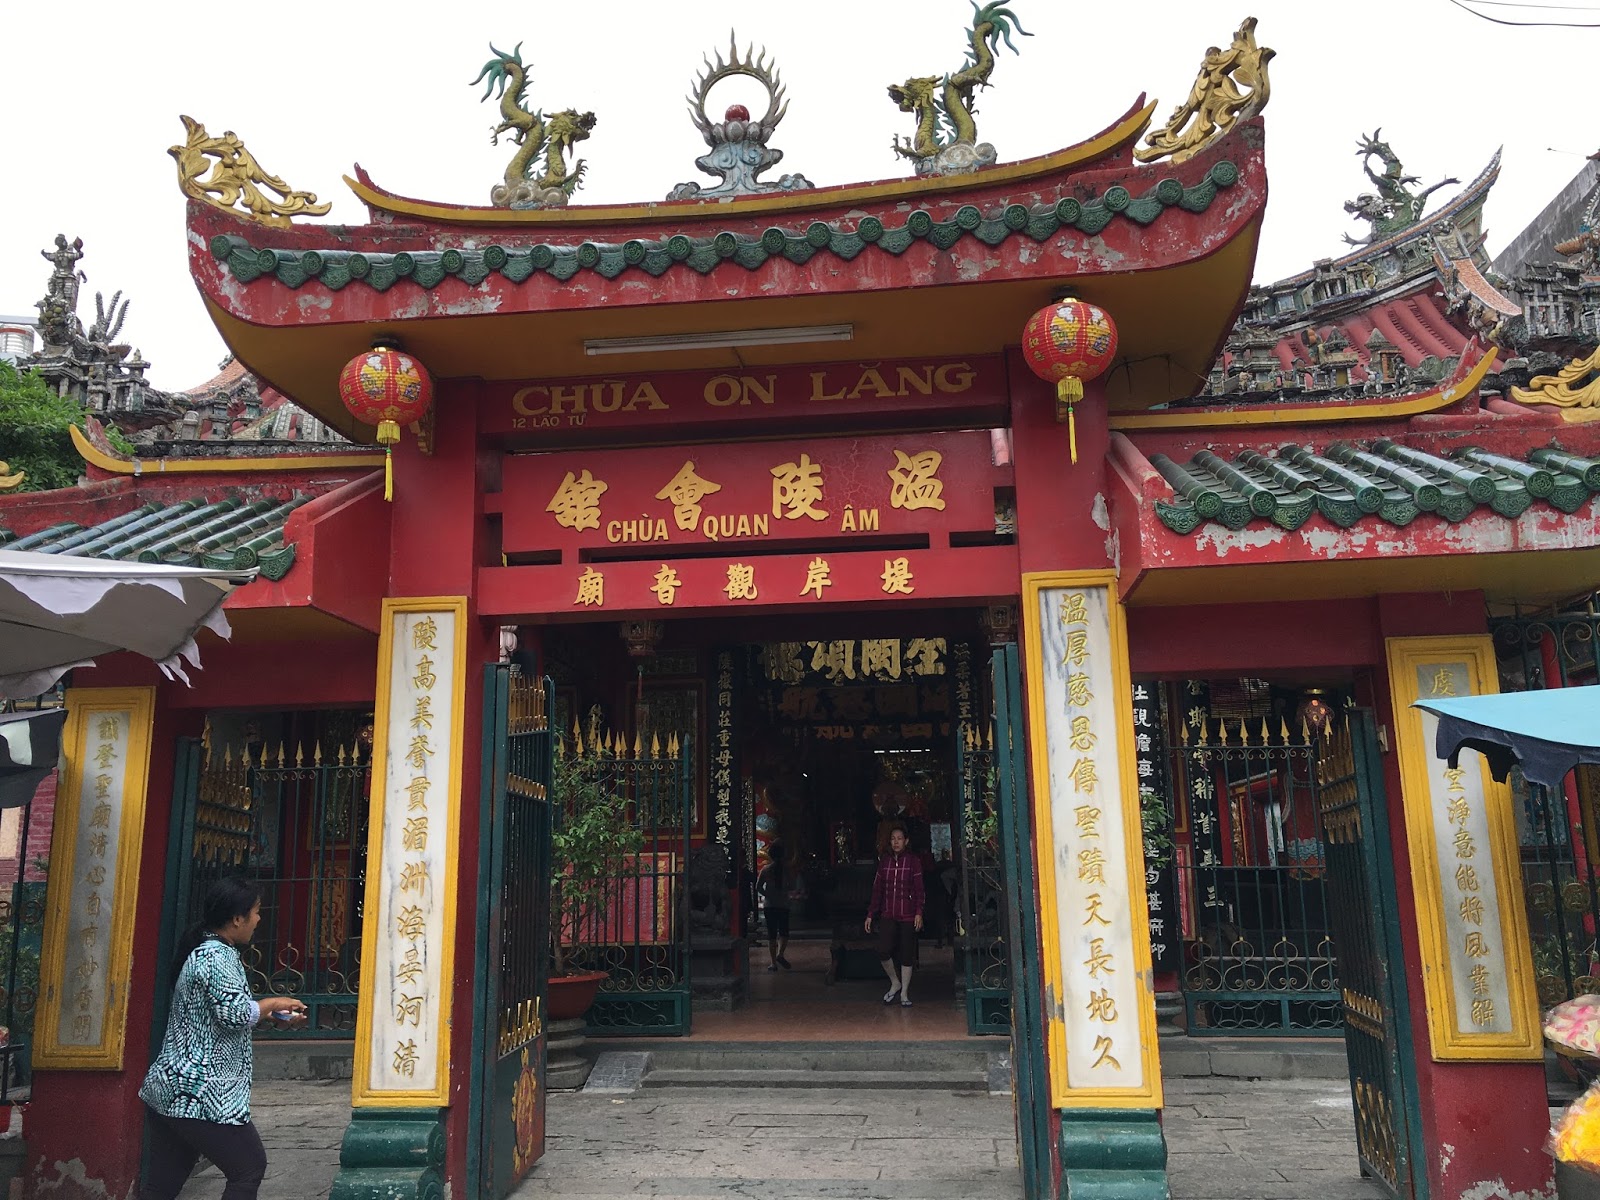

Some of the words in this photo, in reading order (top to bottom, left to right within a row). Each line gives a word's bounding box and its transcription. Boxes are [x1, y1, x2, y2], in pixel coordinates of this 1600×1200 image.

[512, 379, 669, 416] CHÙA
[703, 373, 777, 406] ÔN
[809, 361, 977, 401] LĂNG
[512, 418, 526, 429] 12
[606, 512, 669, 544] CHÙA
[702, 512, 770, 541] QUAN
[841, 505, 880, 532] ÂM
